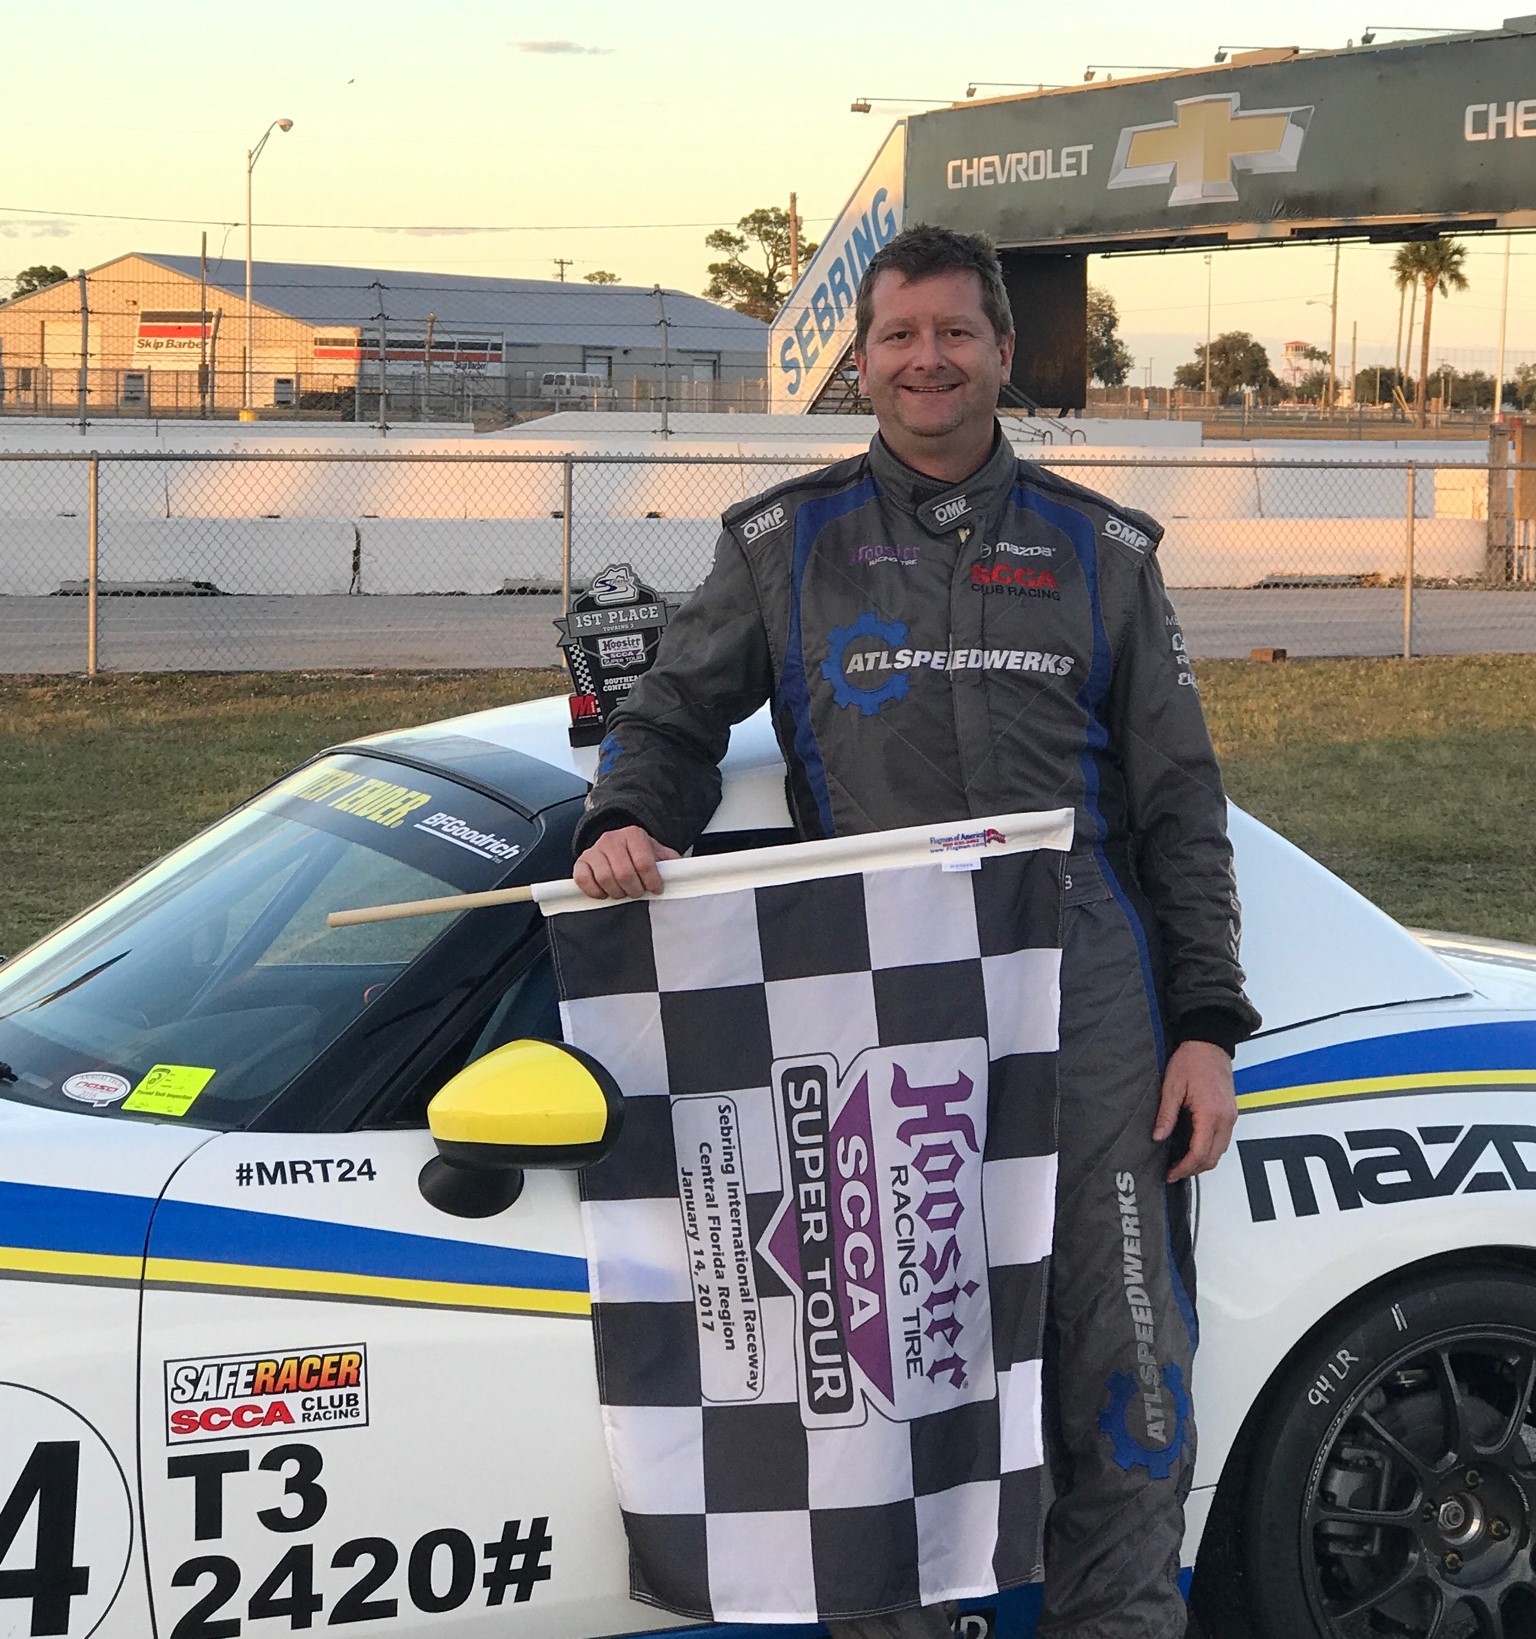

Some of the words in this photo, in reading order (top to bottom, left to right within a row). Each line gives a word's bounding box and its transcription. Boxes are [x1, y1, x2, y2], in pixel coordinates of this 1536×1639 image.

[946, 144, 1093, 190] CHEVROLET
[780, 187, 897, 395] SEBRING
[137, 338, 163, 350] Skip
[743, 507, 784, 538] OMP
[934, 498, 967, 523] OMP
[1104, 518, 1149, 550] OMP
[970, 563, 1058, 590] SCCA
[971, 583, 1004, 595] CLUB
[1008, 586, 1060, 601] RACING
[575, 613, 603, 628] 1ST
[607, 606, 660, 624] PLACE
[610, 651, 634, 659] SCCA
[845, 648, 1075, 677] ATLSPEEDWERKS
[602, 682, 633, 692] CONFER
[603, 675, 638, 685] SOUTHEA
[328, 778, 432, 827] TENDER
[421, 812, 520, 860] BFGoodrich
[75, 1081, 119, 1093] nasa
[235, 1158, 377, 1187] #MRT24
[700, 1141, 719, 1209] Central
[787, 1078, 829, 1245] SUPER
[681, 1167, 700, 1242] January
[889, 1062, 980, 1390] Hoosier
[708, 1215, 725, 1280] Florida
[718, 1104, 735, 1175] Sebring
[727, 1181, 754, 1303] International
[743, 1309, 758, 1392] Raceway
[835, 1134, 881, 1332] SCCA
[890, 1164, 920, 1296] RACING
[693, 1249, 706, 1276] 14,
[699, 1284, 715, 1332] 2017
[718, 1286, 735, 1351] Region
[804, 1258, 849, 1402] TOUR
[1116, 1171, 1167, 1443] ATLSPEEDWERKS
[902, 1307, 925, 1380] TIRE
[170, 1351, 362, 1404] SAFERACER
[1308, 1375, 1335, 1405] 94
[1328, 1349, 1359, 1380] LR
[170, 1400, 296, 1434] SCCA
[301, 1393, 359, 1412] CLUB
[301, 1408, 360, 1423] RACING
[167, 1443, 328, 1542] T3
[0, 1440, 90, 1637] 4
[170, 1515, 553, 1639] 2420#
